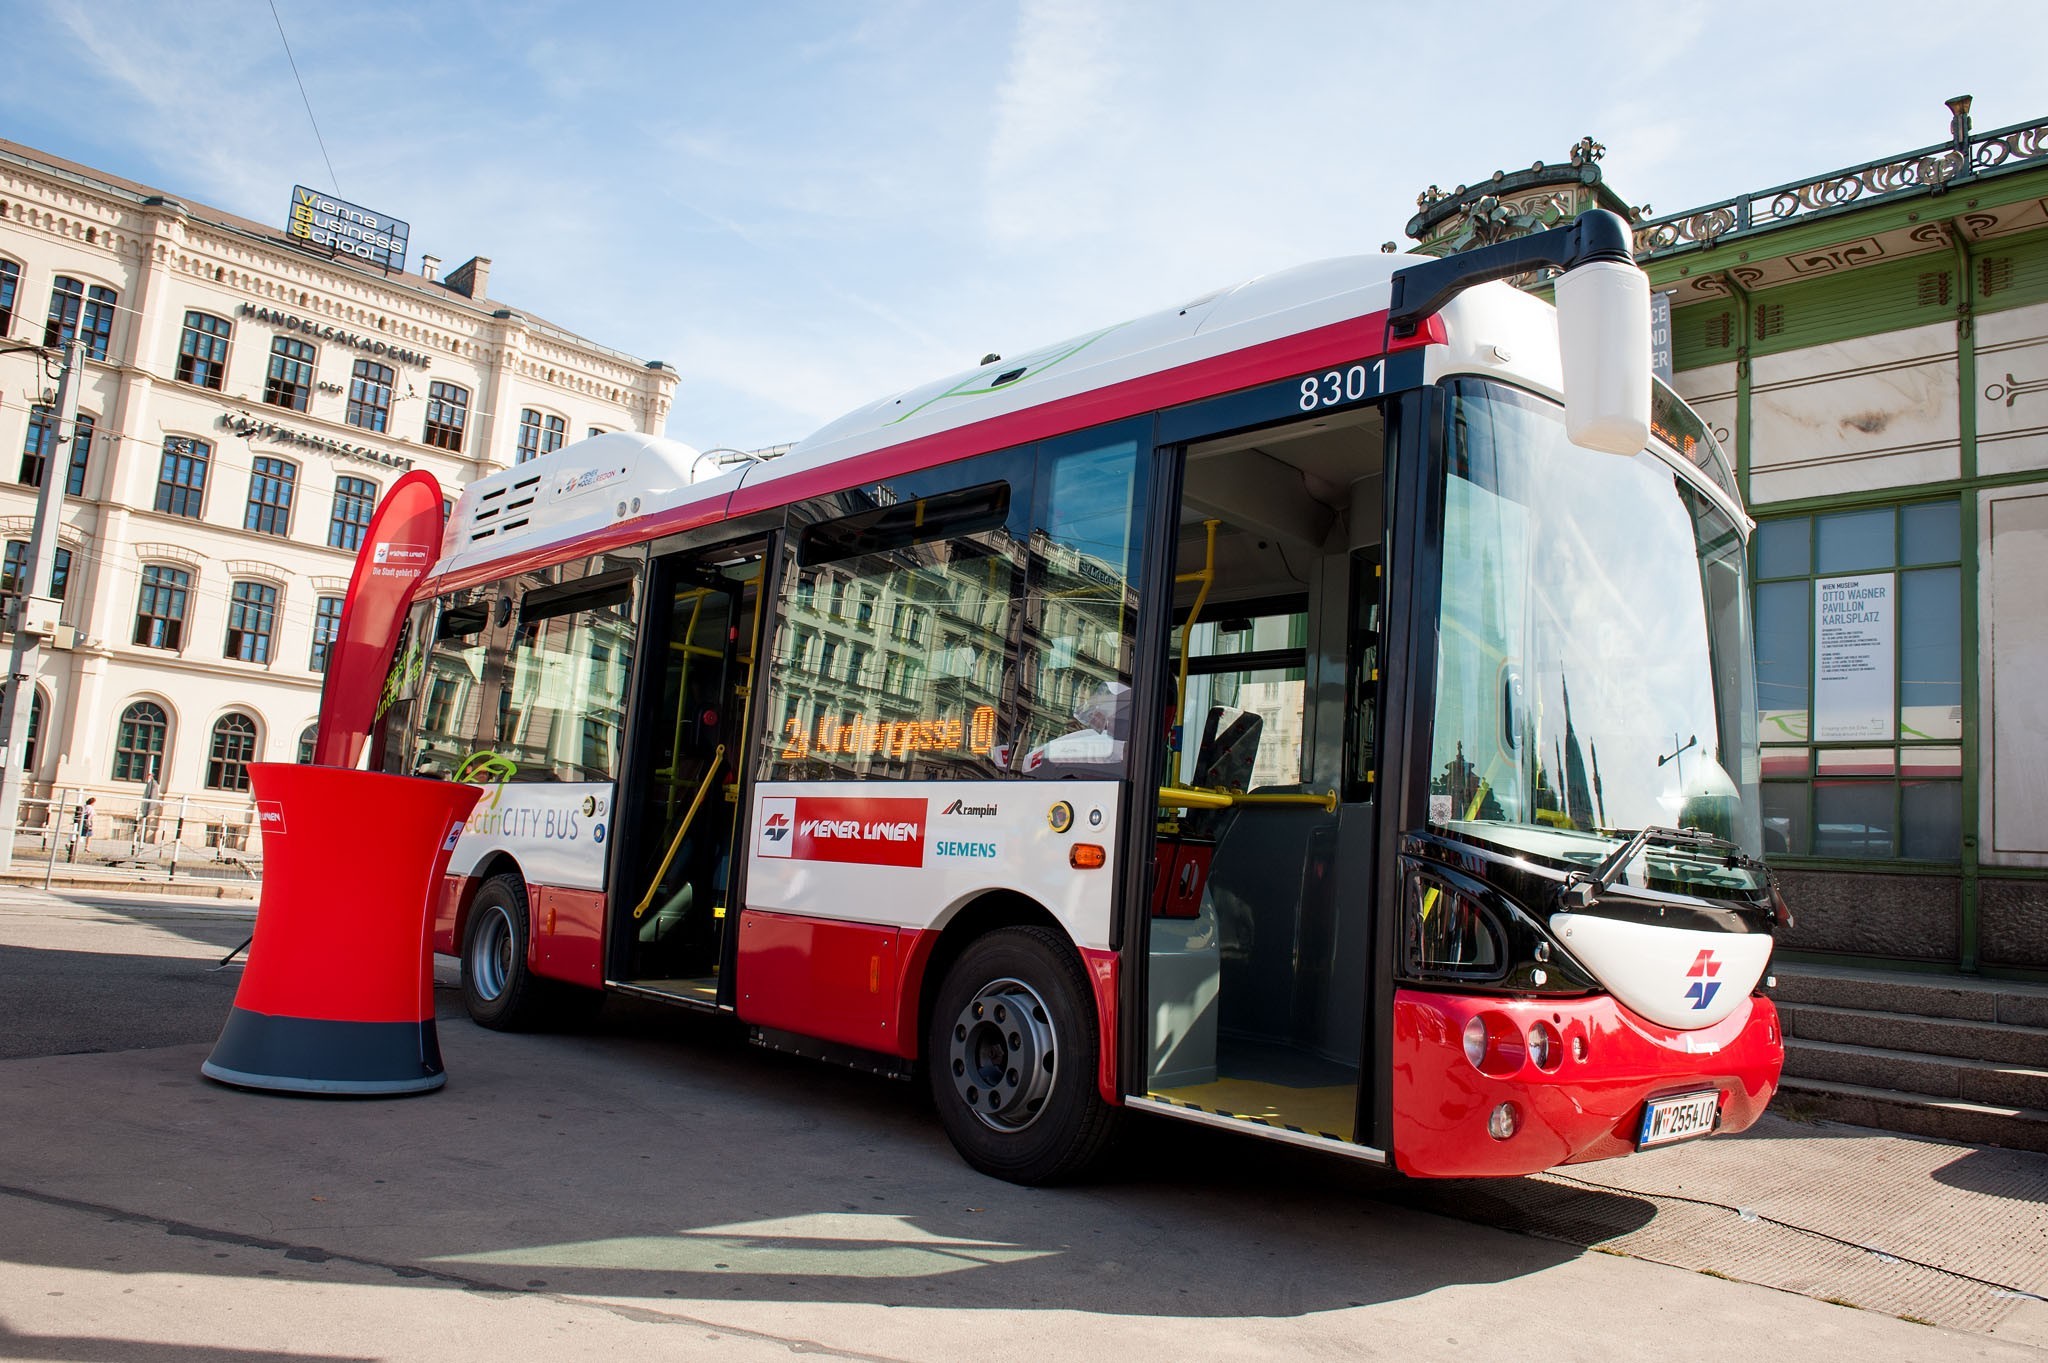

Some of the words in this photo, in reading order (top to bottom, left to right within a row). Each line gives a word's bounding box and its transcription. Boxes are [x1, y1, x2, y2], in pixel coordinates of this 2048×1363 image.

[300, 189, 378, 229] Vienna
[293, 221, 375, 260] School
[295, 205, 402, 253] Business
[240, 301, 432, 370] HANDELSAKADEMIE
[319, 381, 344, 395] DER
[1299, 359, 1386, 411] 8301
[1823, 590, 1845, 602] OTTO
[1848, 587, 1886, 600] WAGNER
[1837, 581, 1858, 589] MUSEUM
[1823, 601, 1864, 613] PAVILLON
[1823, 611, 1879, 625] KARLSPLATZ
[816, 713, 962, 756] Kirchengasse
[466, 807, 542, 839] ectriCITY
[545, 809, 580, 840] BUS
[963, 803, 997, 818] rampini
[800, 820, 861, 840] WIENER
[863, 821, 918, 842] LINIEN
[936, 841, 997, 858] SIEMENS
[1653, 1106, 1664, 1137] W
